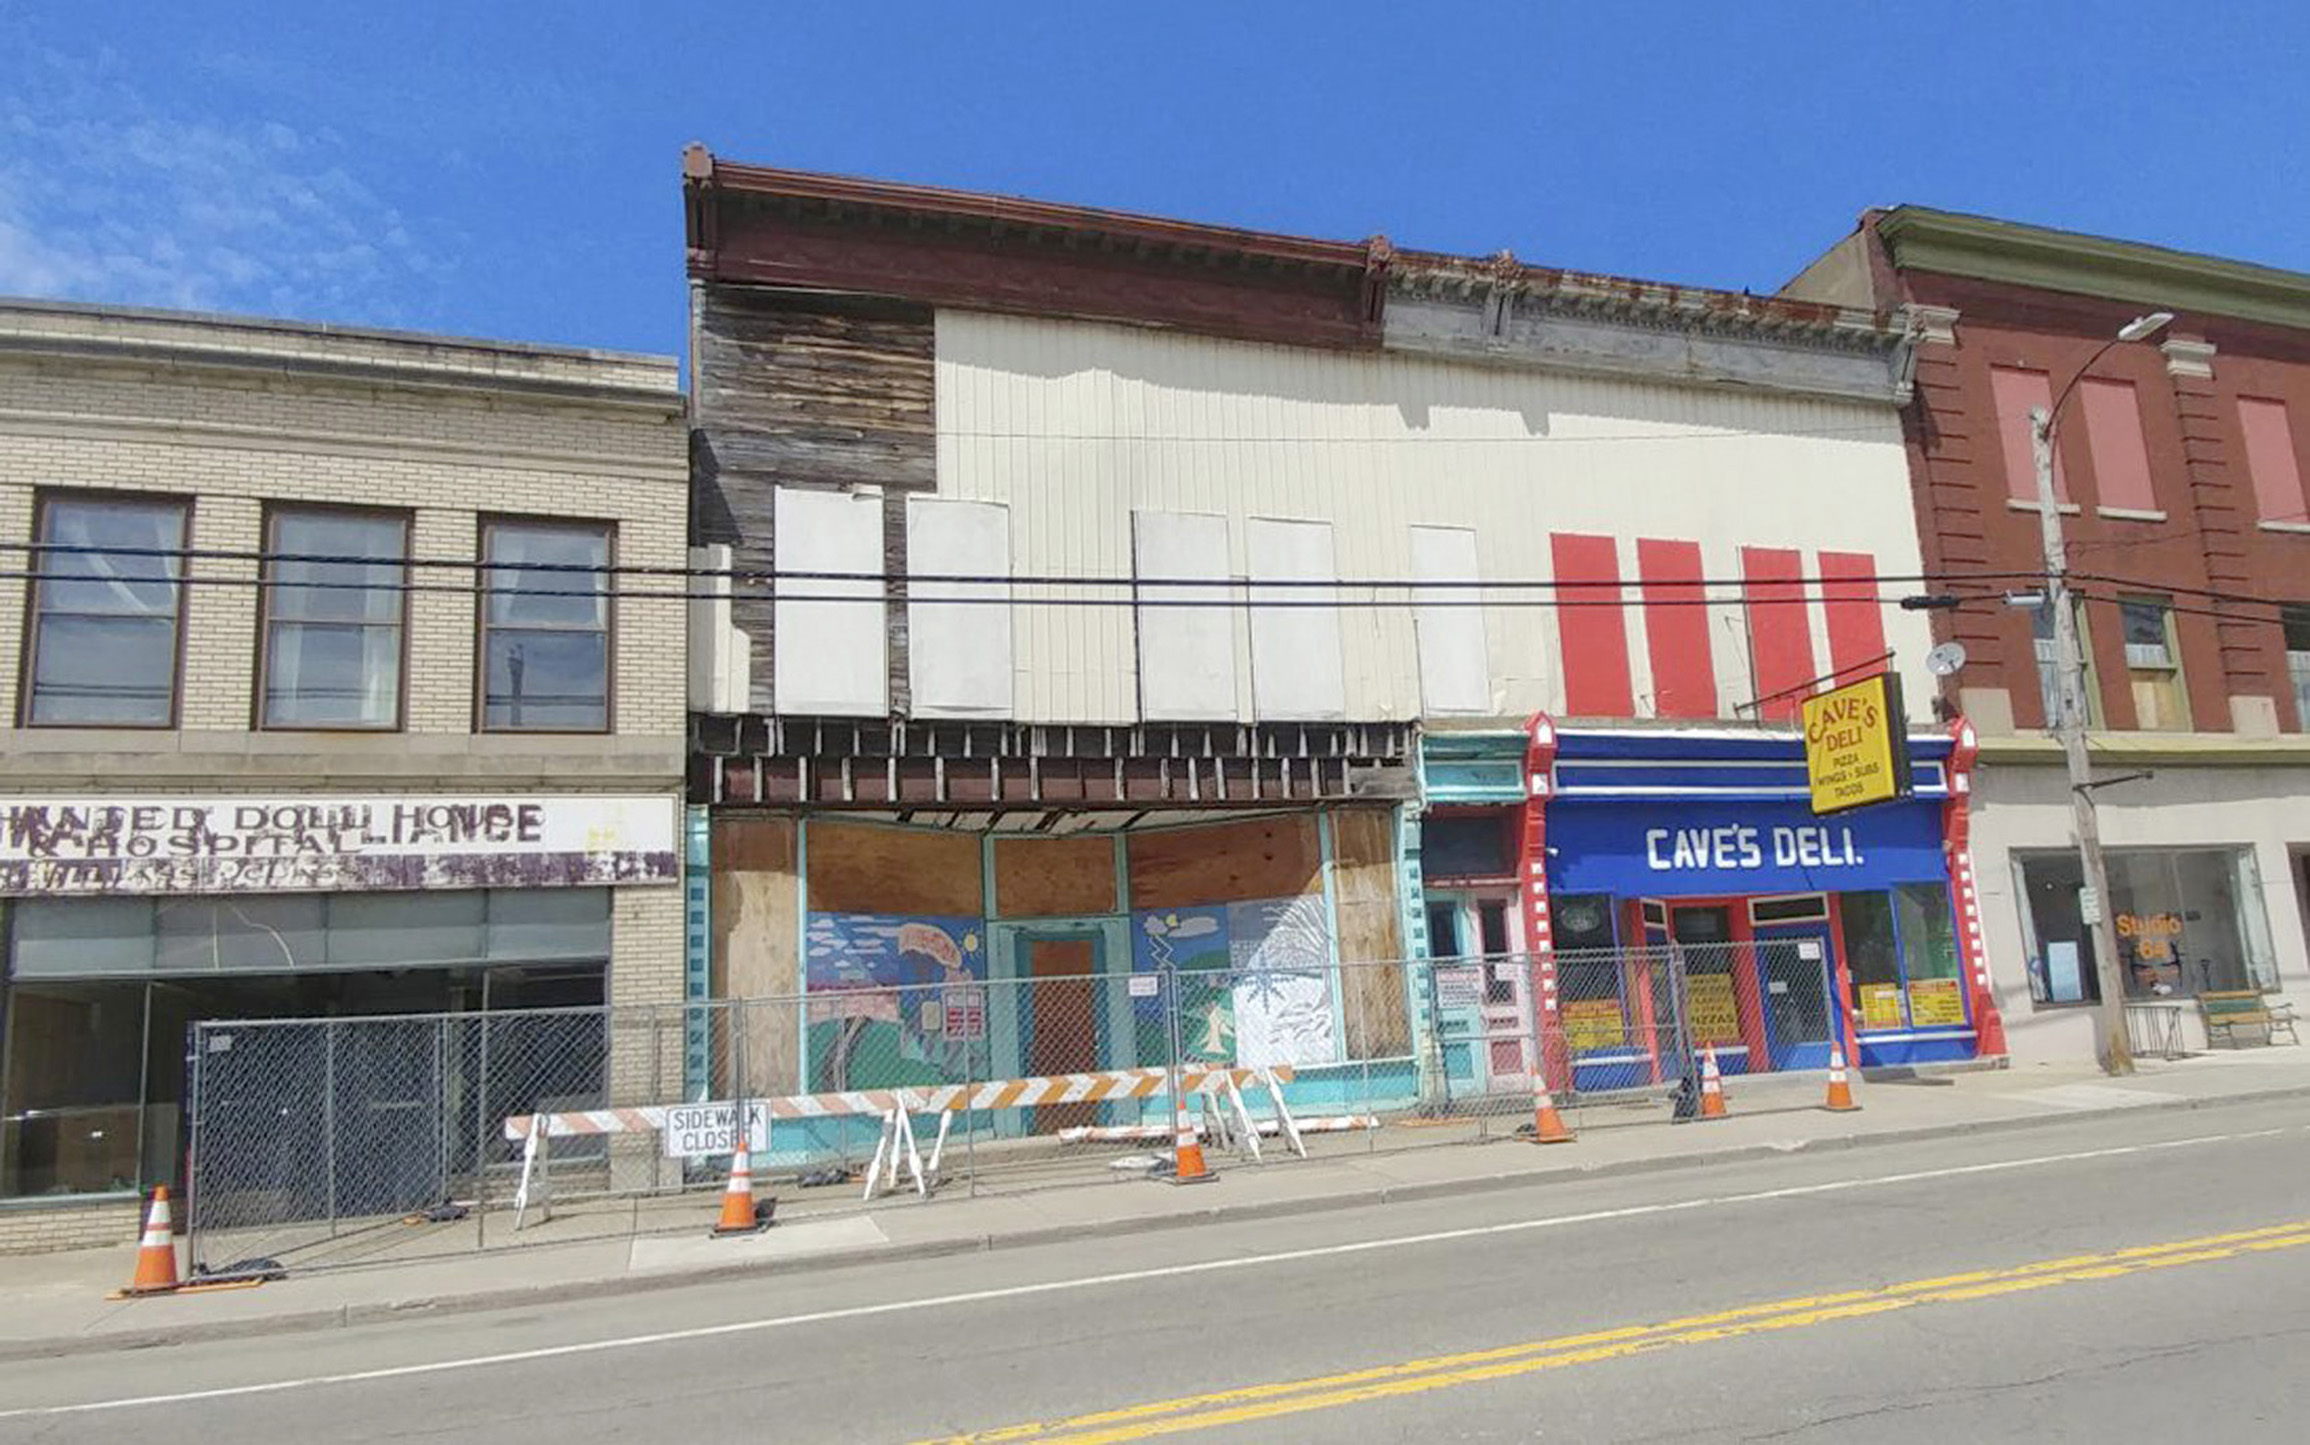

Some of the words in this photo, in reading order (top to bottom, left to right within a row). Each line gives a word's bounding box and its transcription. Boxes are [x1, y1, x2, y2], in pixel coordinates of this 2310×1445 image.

[1808, 698, 1878, 744] CAVE'S
[1826, 727, 1863, 751] DELI
[86, 834, 363, 857] HOSPITAL
[1647, 823, 1762, 869] CAVE'S
